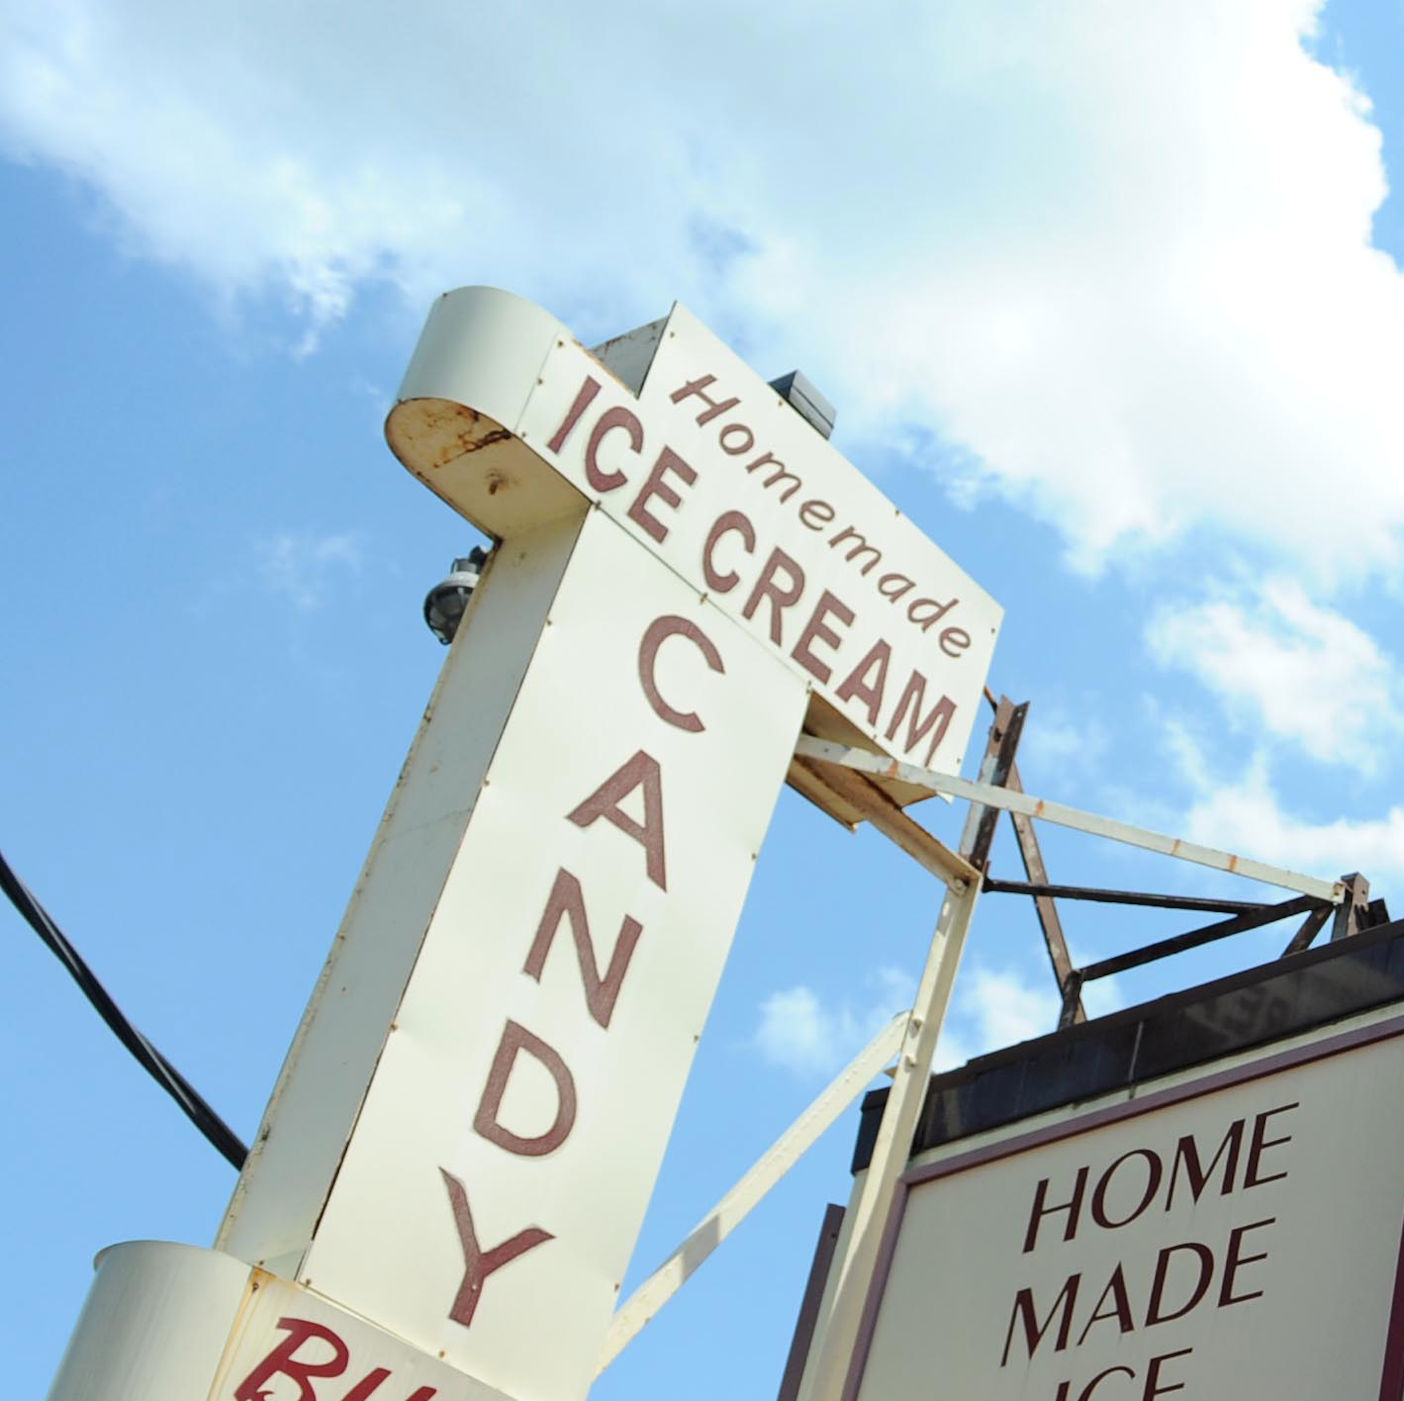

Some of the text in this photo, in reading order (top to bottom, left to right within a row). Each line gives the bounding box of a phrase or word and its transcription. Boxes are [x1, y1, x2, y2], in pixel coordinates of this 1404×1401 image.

[546, 376, 956, 767] ICE CREAM
[669, 373, 972, 659] Homemade
[438, 613, 725, 1329] CANDY
[1000, 1217, 1276, 1367] MADE
[1022, 1102, 1299, 1254] HOME
